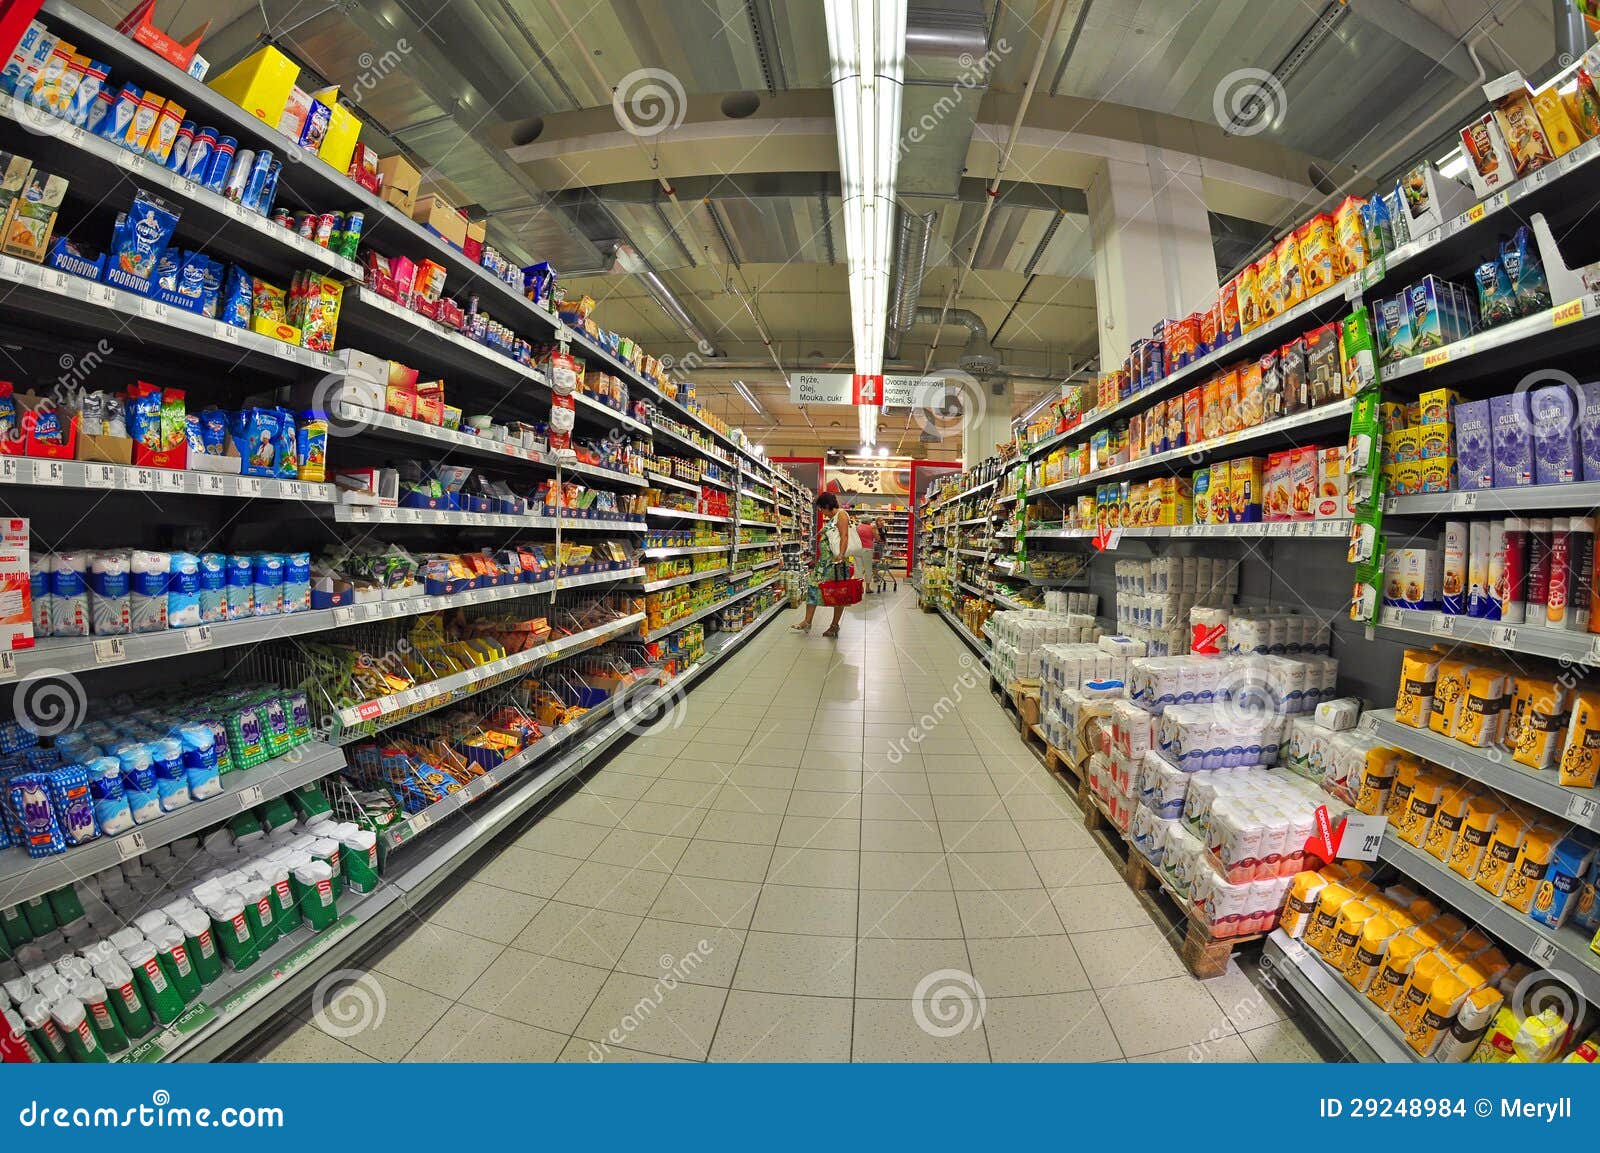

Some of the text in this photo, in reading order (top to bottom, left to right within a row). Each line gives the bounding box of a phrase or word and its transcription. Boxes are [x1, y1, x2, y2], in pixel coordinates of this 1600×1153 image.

[55, 253, 98, 279] PODRAVKA
[108, 268, 151, 294] PODRAVKA
[161, 292, 194, 308] PODRAVKA
[1554, 303, 1581, 322] AKCE
[1425, 352, 1447, 365] AKCE
[800, 385, 816, 394] Olej,
[860, 379, 876, 401] 4
[885, 387, 911, 396] konzervy
[137, 403, 160, 414] Vegeta
[1422, 398, 1444, 409] CAMPING
[162, 407, 186, 418] Vegeta
[1540, 407, 1561, 419] CUKR
[1499, 413, 1520, 425] CUKR
[35, 421, 57, 432] geta
[1462, 420, 1481, 431] CUKR
[1396, 436, 1417, 446] CAMPING
[1421, 431, 1445, 441] CAMPING
[1398, 469, 1419, 478] CAMPING
[1423, 465, 1445, 475] CAMPING
[361, 705, 380, 716] SLEVA
[1363, 835, 1374, 852] 22
